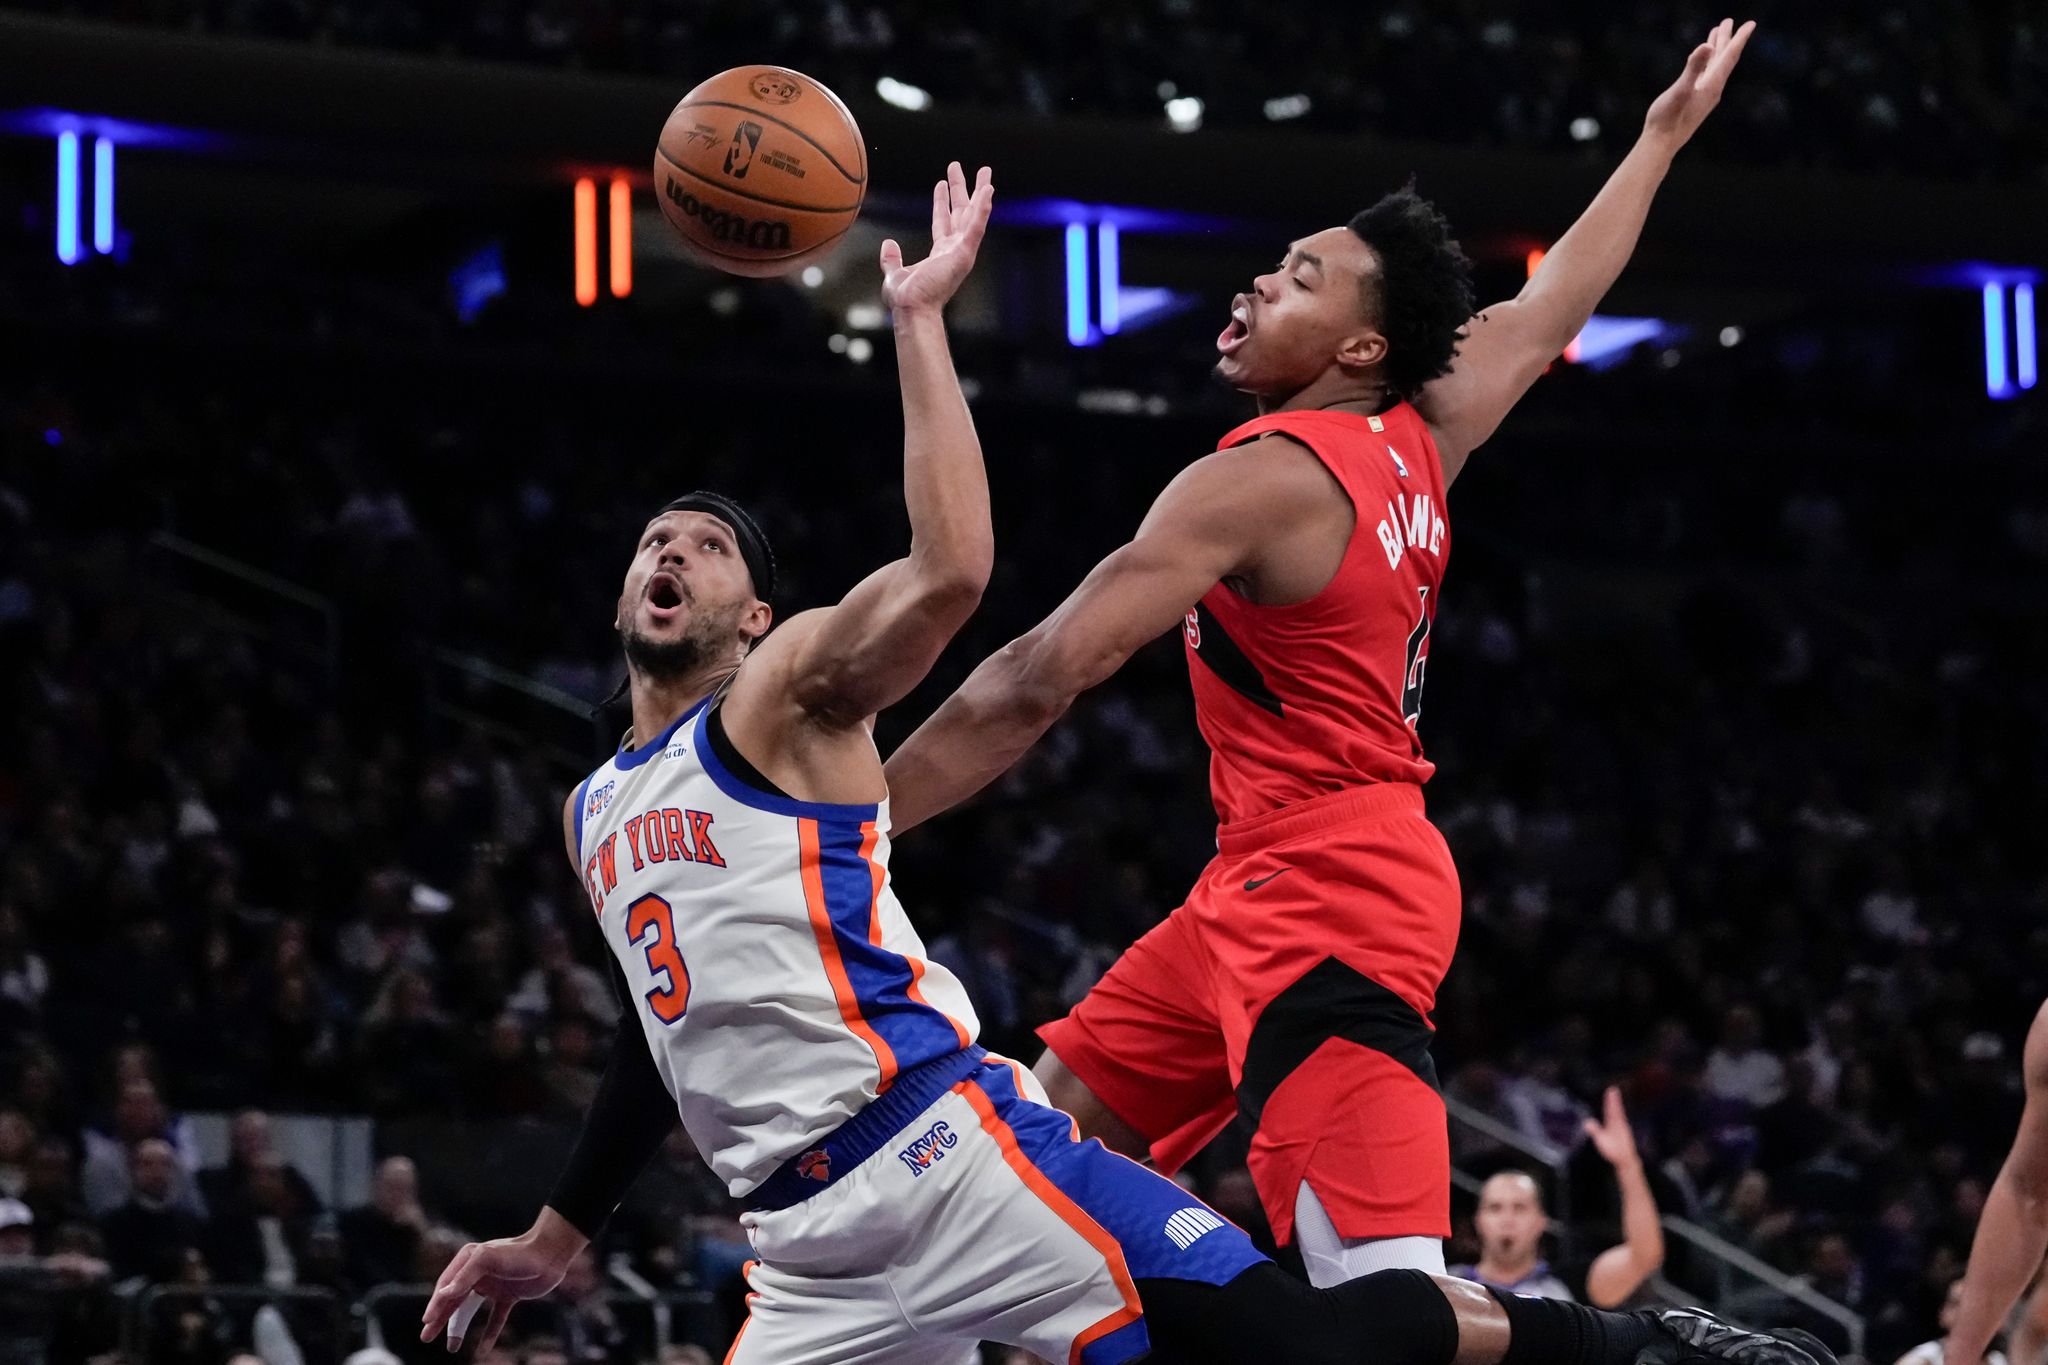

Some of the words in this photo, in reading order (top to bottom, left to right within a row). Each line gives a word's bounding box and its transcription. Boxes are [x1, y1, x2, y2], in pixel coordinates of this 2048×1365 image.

[585, 780, 615, 821] NYC
[586, 831, 618, 922] EW
[624, 808, 727, 872] YORK
[625, 892, 691, 1026] 3
[898, 1121, 958, 1178] NYC
